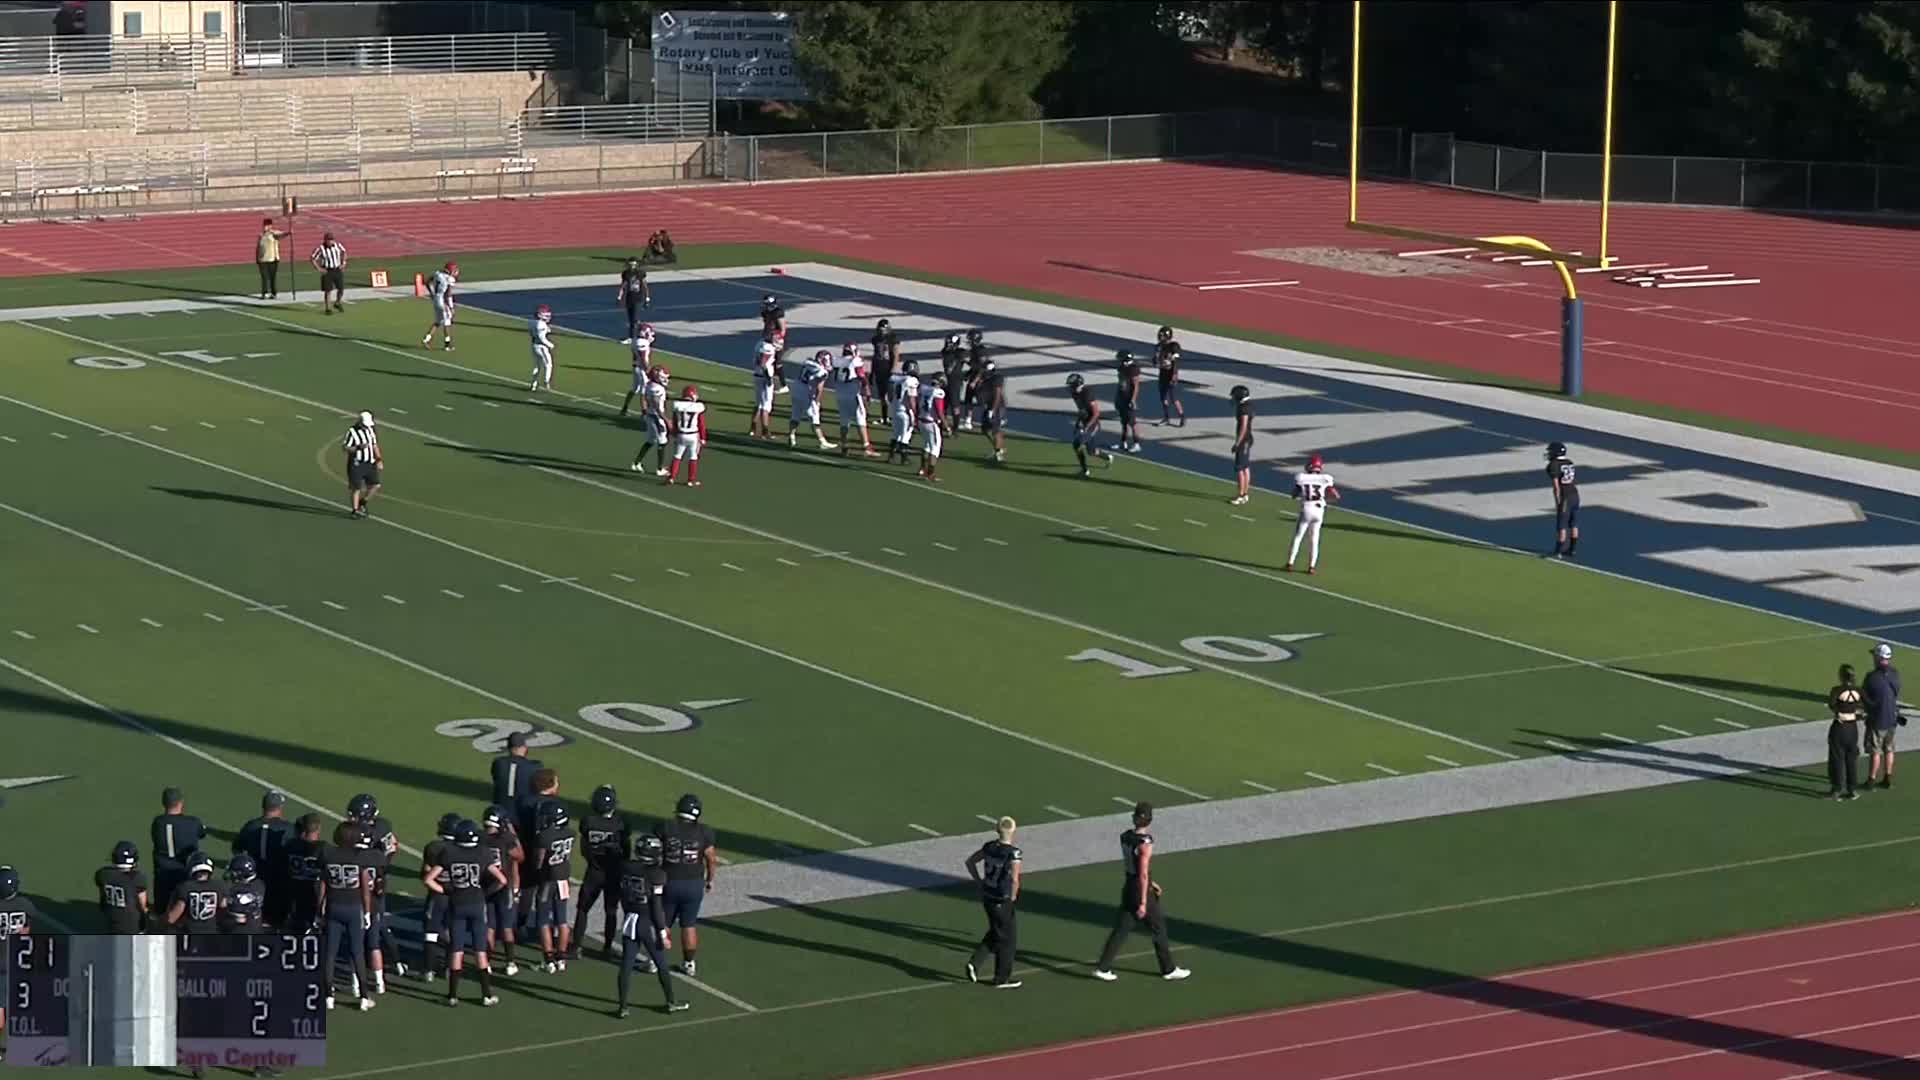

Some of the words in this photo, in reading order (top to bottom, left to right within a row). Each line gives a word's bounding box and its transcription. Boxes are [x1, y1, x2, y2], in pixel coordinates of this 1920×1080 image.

[660, 46, 706, 60] Rotary
[710, 47, 740, 58] Club
[745, 48, 758, 58] of
[679, 411, 694, 429] 17
[1303, 484, 1322, 501] 13
[1065, 634, 1295, 679] 10
